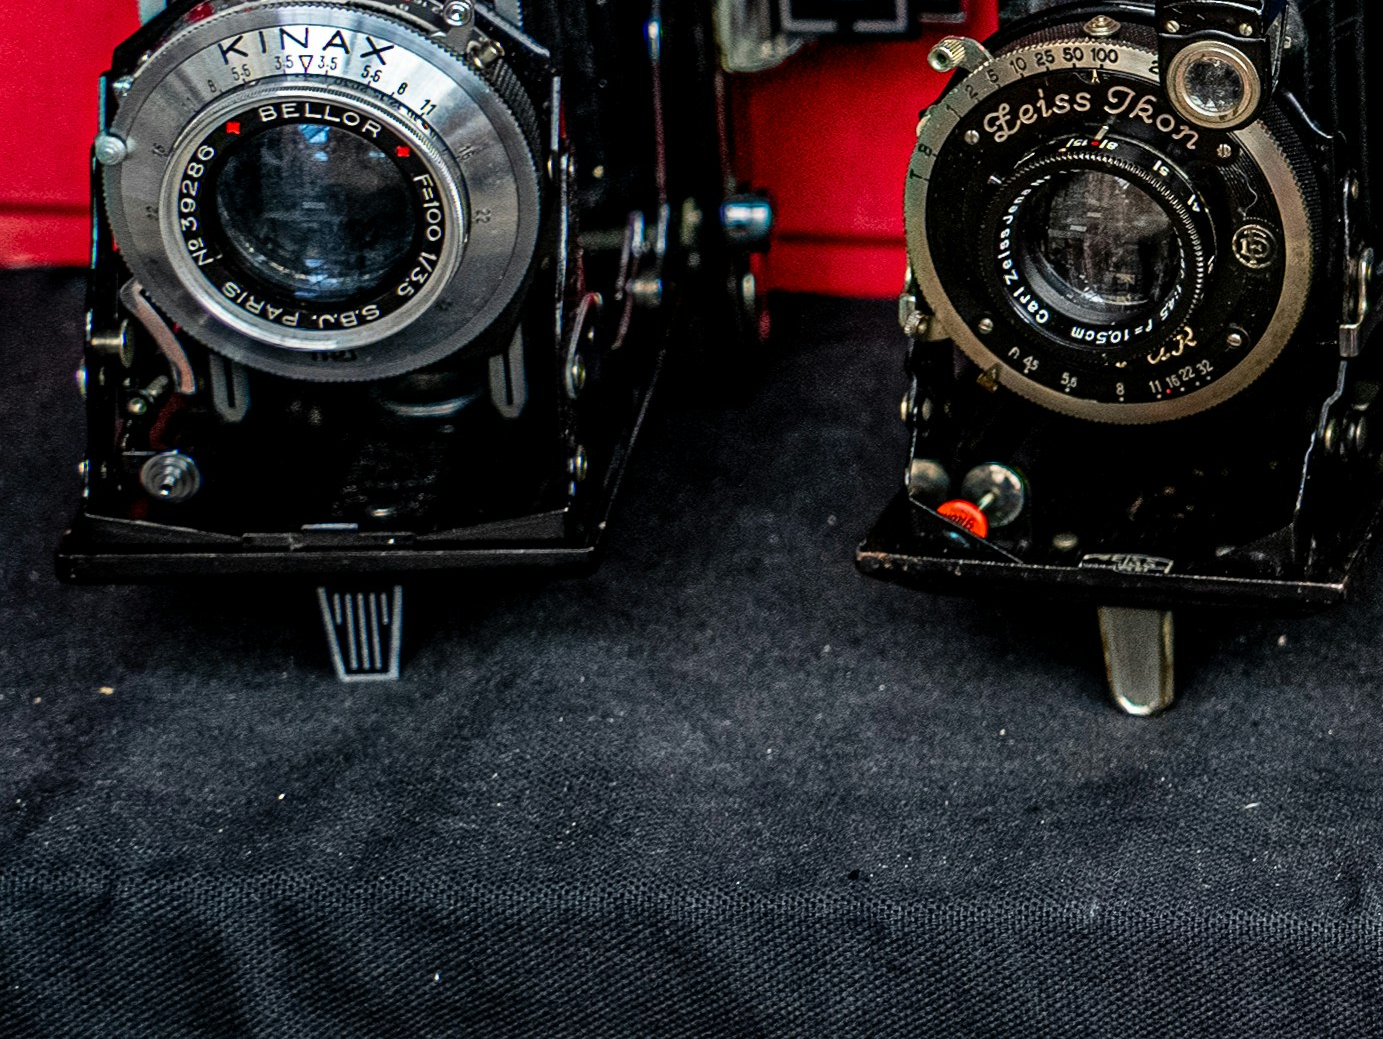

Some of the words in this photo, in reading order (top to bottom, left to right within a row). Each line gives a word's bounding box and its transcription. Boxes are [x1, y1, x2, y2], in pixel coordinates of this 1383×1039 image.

[218, 27, 395, 65] KINAX
[397, 81, 408, 95] 8
[965, 84, 979, 99] 2
[986, 68, 999, 84] 5
[1009, 57, 1028, 73] 10
[1035, 51, 1055, 67] 25
[1062, 46, 1084, 63] 50
[1091, 47, 1119, 64] 100
[258, 102, 382, 138] BELLOR
[983, 88, 1091, 143] Zeiss
[1103, 86, 1200, 150] Ikon
[180, 144, 215, 232] 39286
[997, 228, 1019, 285] Zeiss
[222, 281, 299, 327] PARIS
[1013, 286, 1050, 324] Carl
[1115, 382, 1125, 396] 8
[1148, 379, 1163, 393] 11
[1165, 374, 1181, 388] 16
[1179, 365, 1196, 381] 22
[1195, 359, 1214, 375] 32
